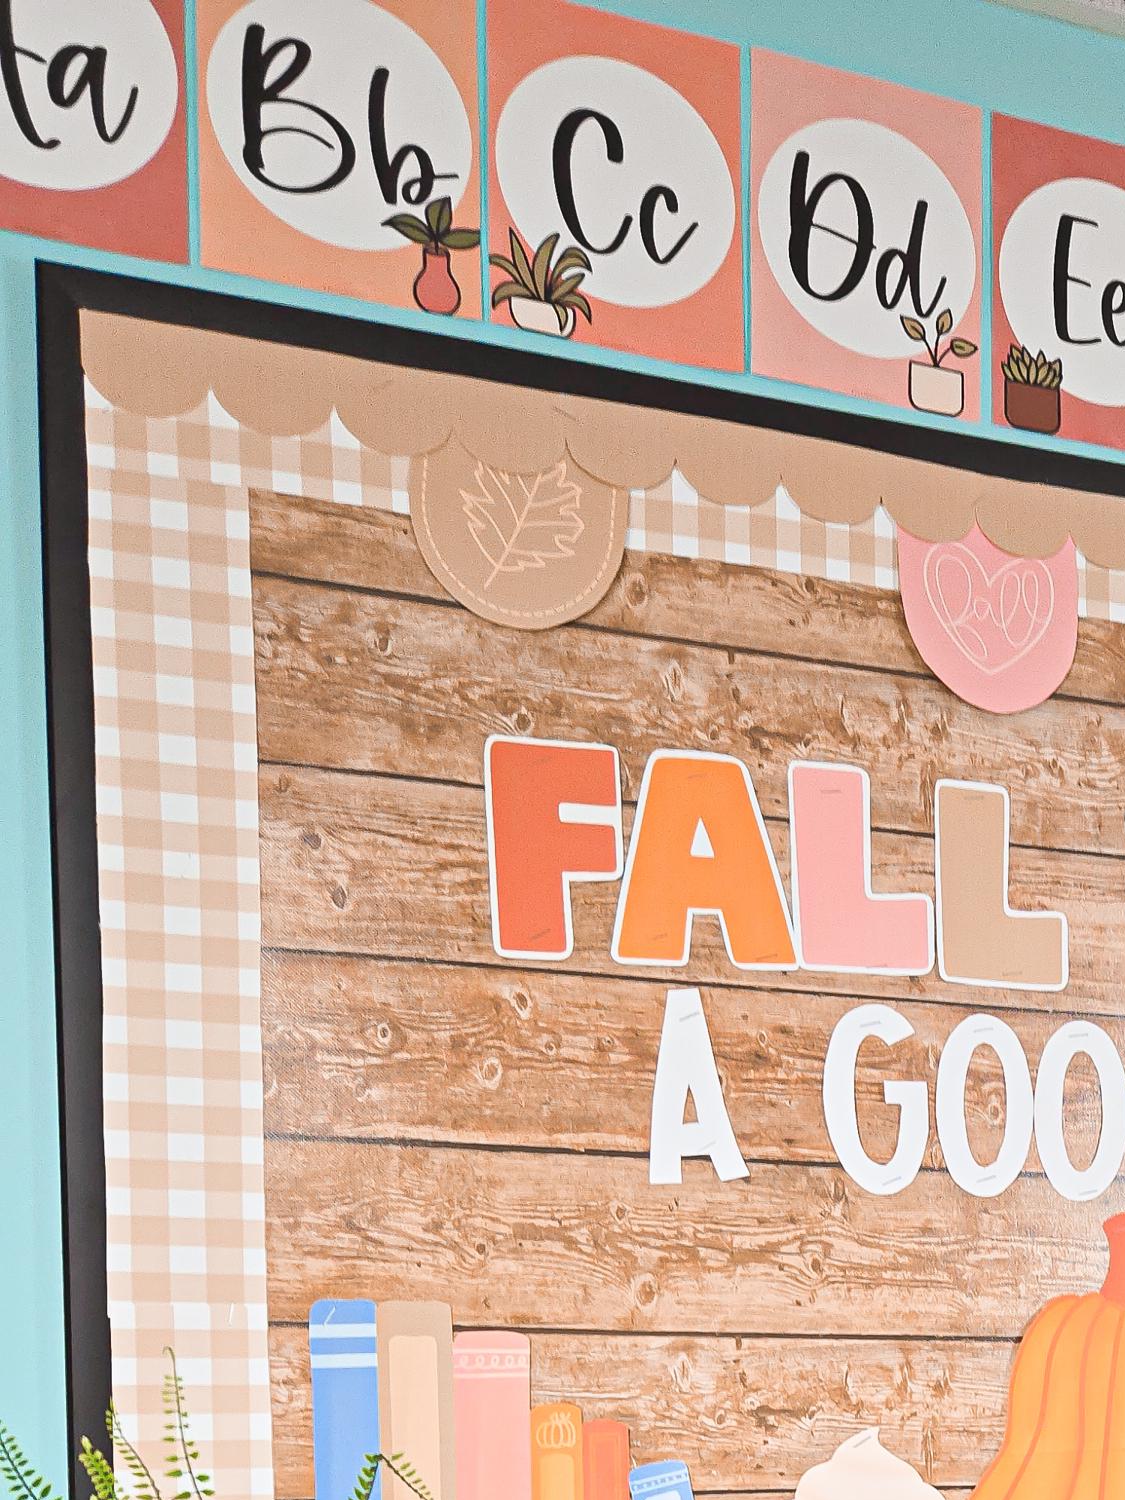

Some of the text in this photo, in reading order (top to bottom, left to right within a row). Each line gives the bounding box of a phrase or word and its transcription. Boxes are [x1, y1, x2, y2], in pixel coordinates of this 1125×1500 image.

[242, 24, 458, 205] Bb
[552, 109, 698, 264] Cc
[788, 150, 946, 316] Dd
[484, 734, 1069, 992] FALL
[649, 988, 751, 1184] A
